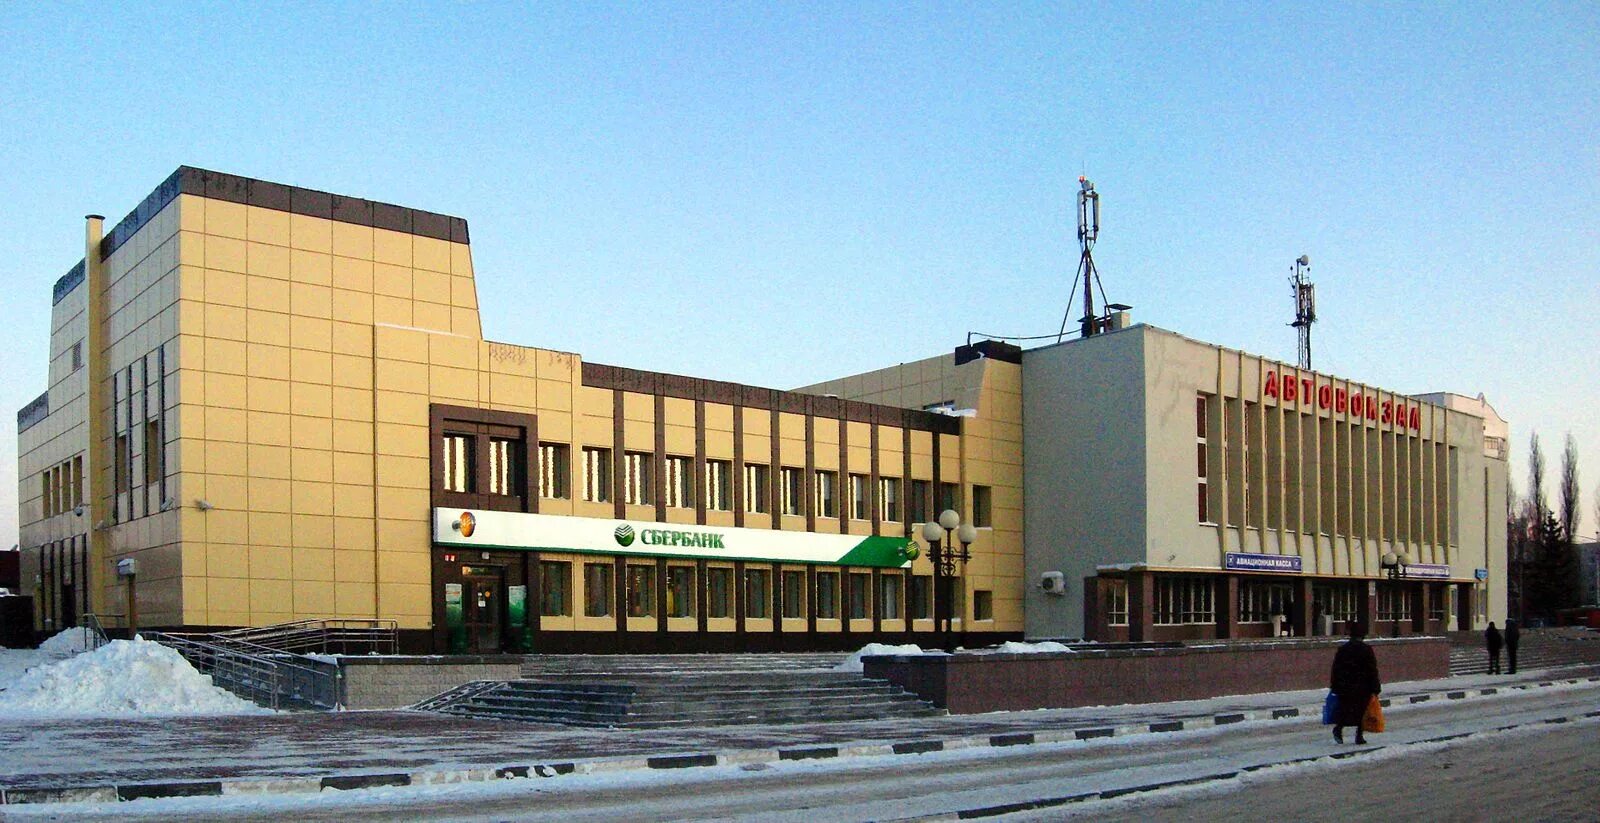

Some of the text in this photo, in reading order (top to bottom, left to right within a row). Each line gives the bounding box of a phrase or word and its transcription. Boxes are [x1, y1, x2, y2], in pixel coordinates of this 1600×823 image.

[1265, 371, 1419, 430] АВТОВОКЗАЛ
[641, 529, 725, 549] СБЕРБАНК
[1236, 557, 1292, 567] АВИАЦИОННАЯ КАССА
